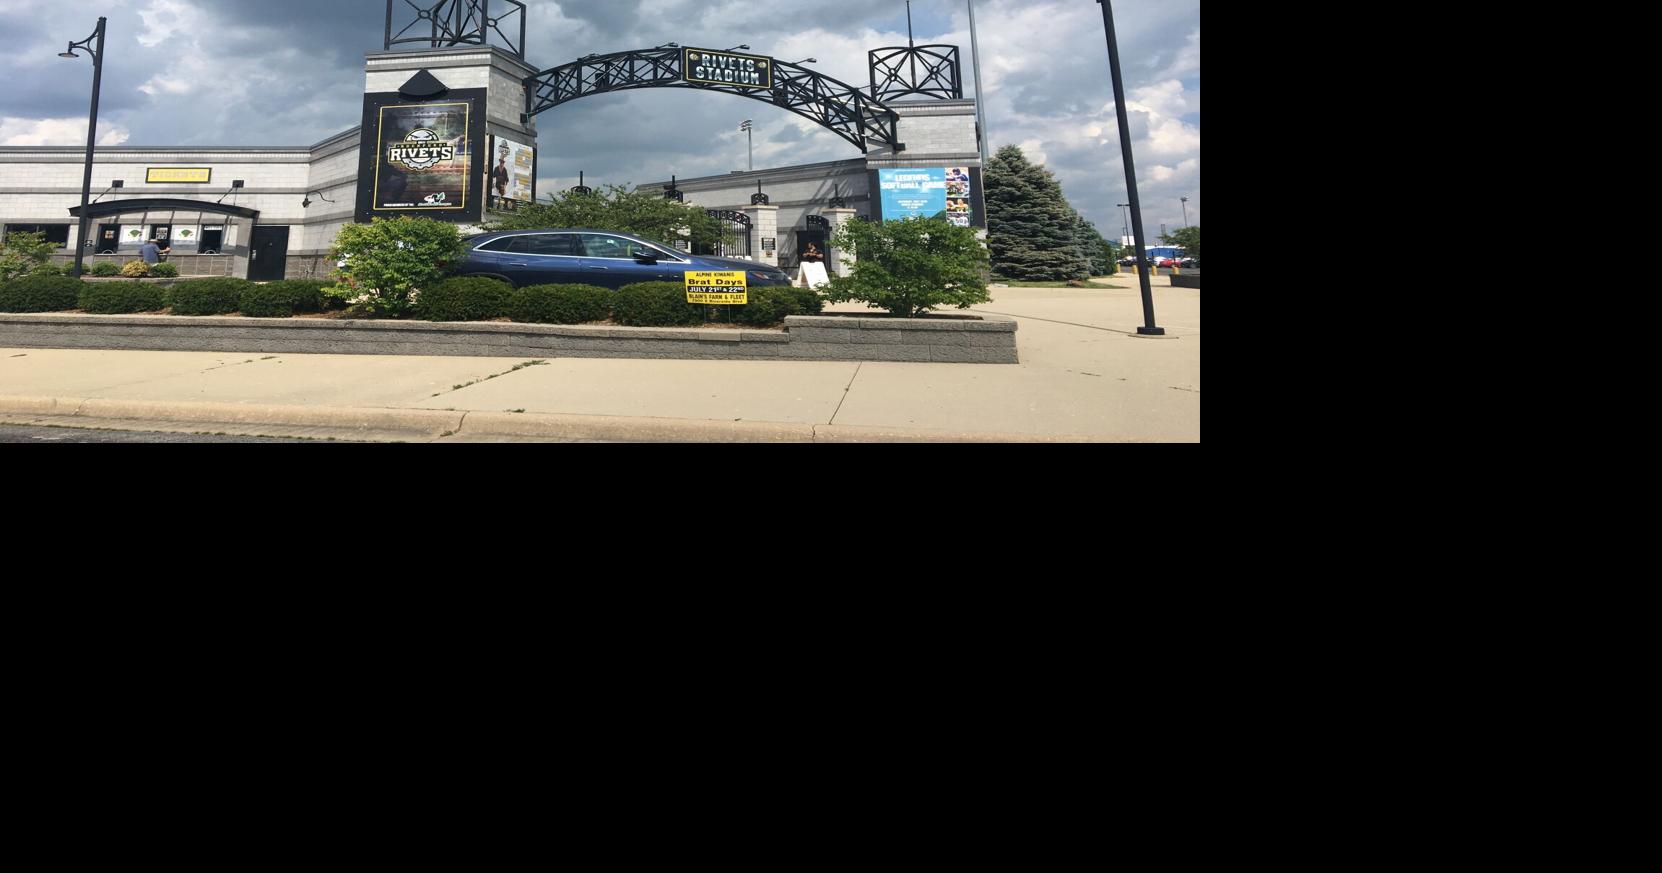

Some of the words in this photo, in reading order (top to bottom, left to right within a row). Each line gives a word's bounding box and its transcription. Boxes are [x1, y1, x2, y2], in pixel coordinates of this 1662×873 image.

[701, 53, 755, 72] RIVETS
[695, 66, 760, 85] STADIUM
[390, 147, 453, 161] RIVETS
[715, 278, 743, 286] Days
